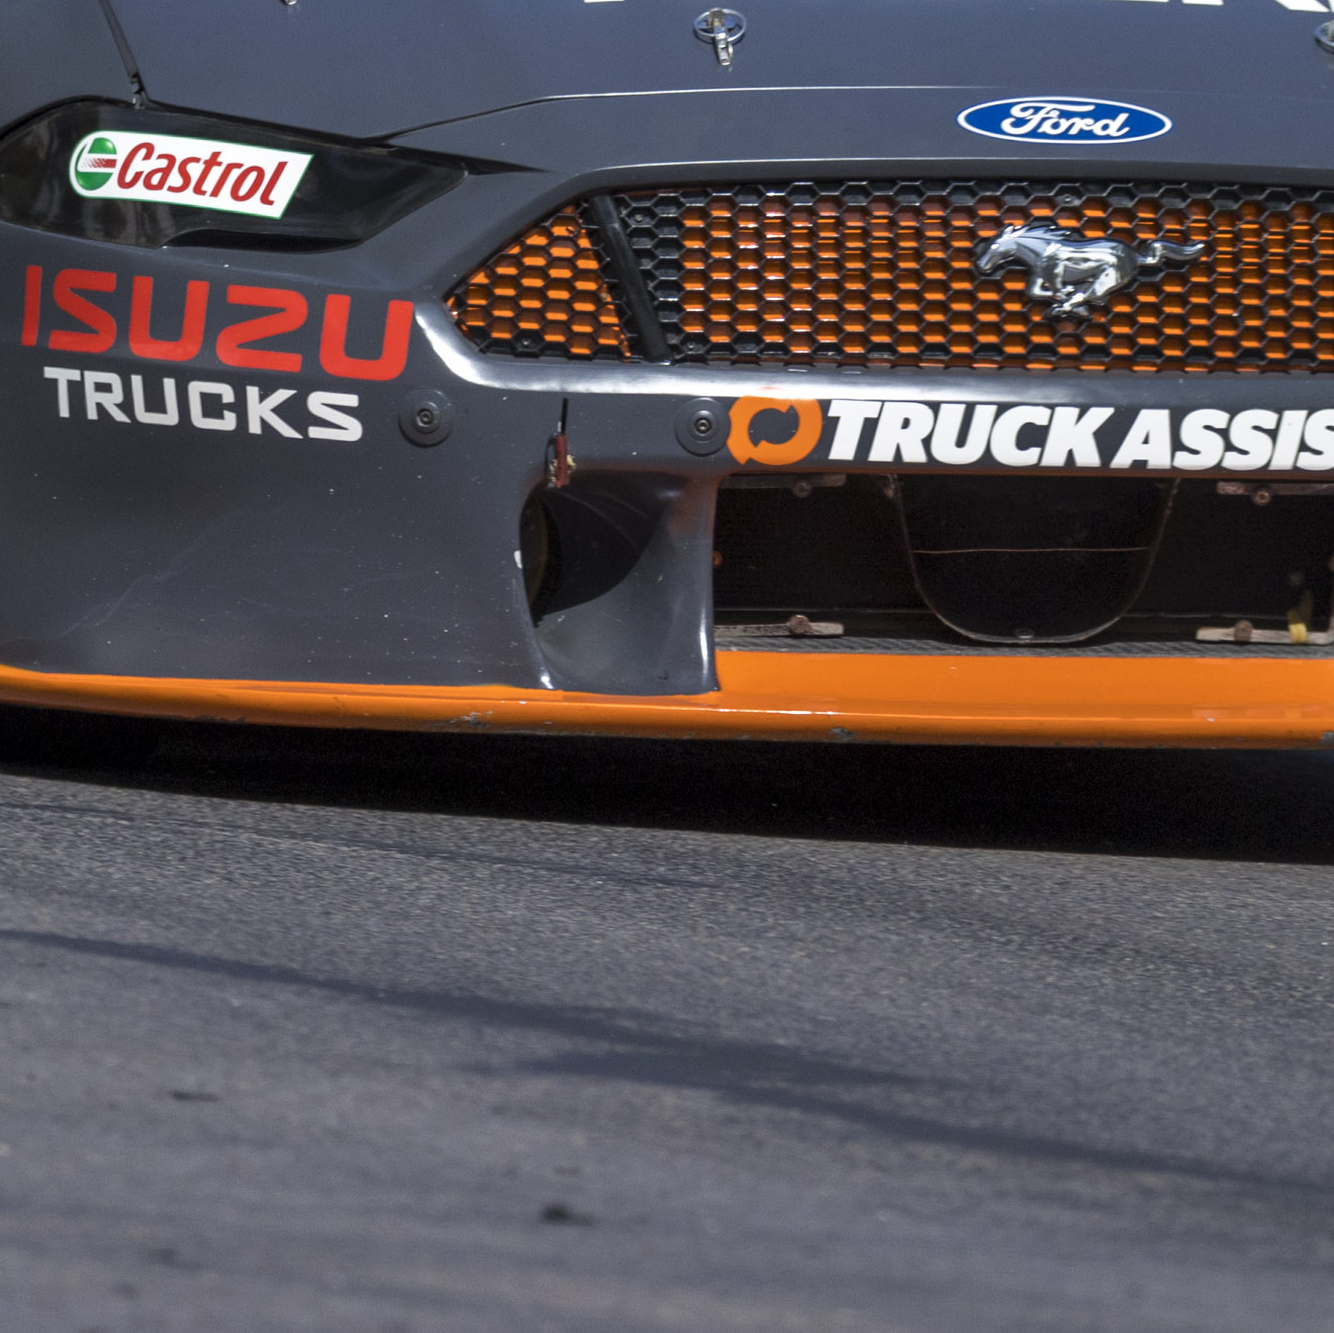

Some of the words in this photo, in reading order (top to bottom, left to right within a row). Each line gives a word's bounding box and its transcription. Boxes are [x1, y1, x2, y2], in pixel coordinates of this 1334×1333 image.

[1000, 101, 1130, 137] Ford
[116, 142, 288, 206] Castrol
[21, 265, 415, 381] ISUZU
[43, 366, 364, 443] TRUCKS
[827, 398, 1116, 466] TRUCK
